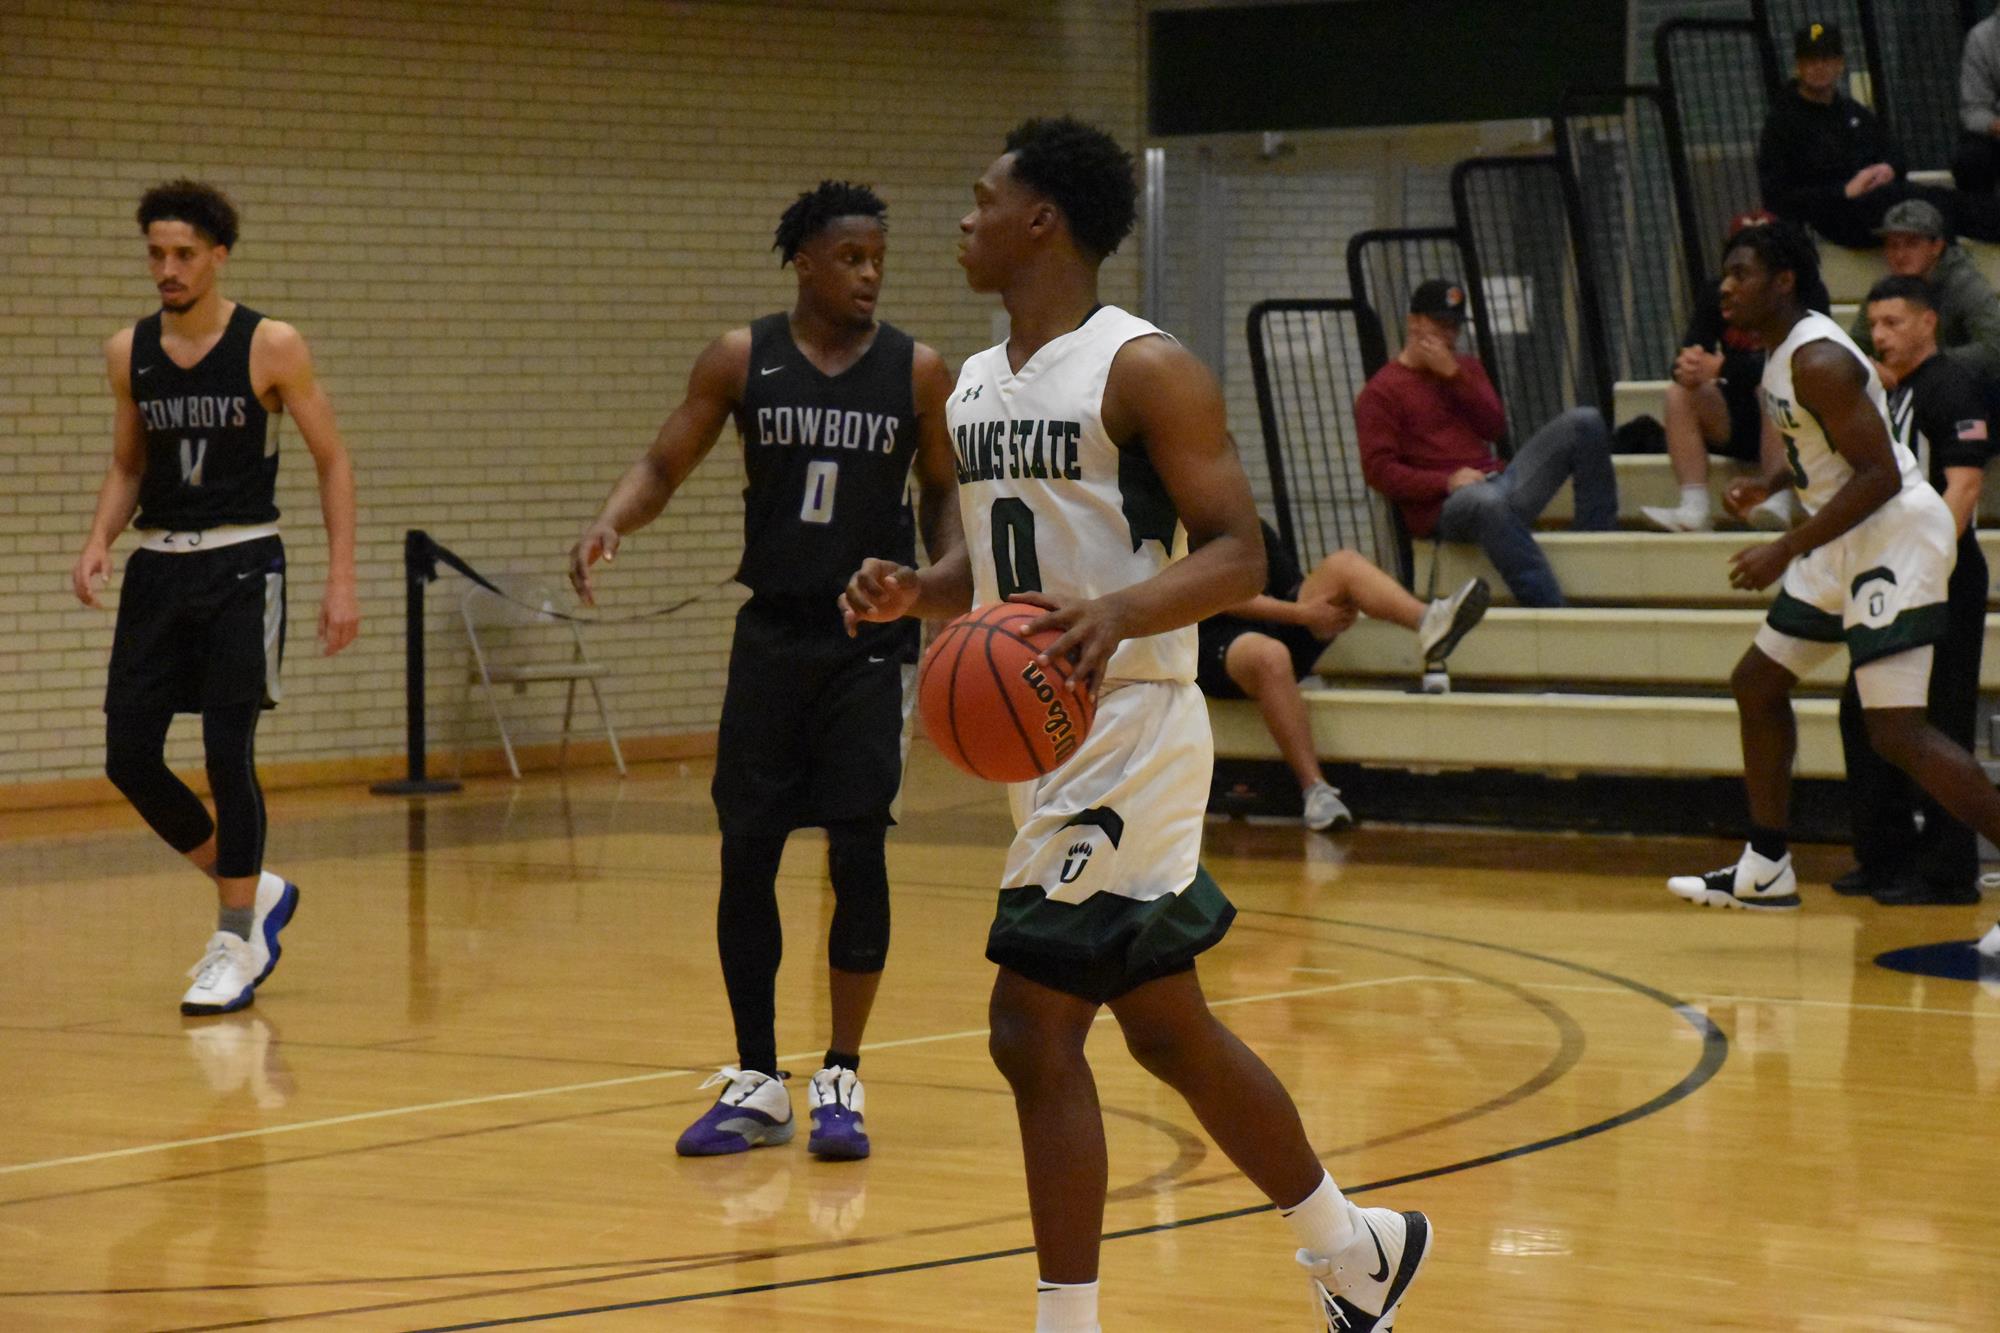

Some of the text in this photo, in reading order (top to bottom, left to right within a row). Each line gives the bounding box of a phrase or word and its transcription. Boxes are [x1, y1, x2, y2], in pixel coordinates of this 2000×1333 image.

[138, 395, 247, 431] COWBOYS
[757, 406, 899, 454] COWBOYS
[1009, 419, 1082, 480] STATE
[800, 460, 839, 524] 0
[990, 497, 1043, 602] 0
